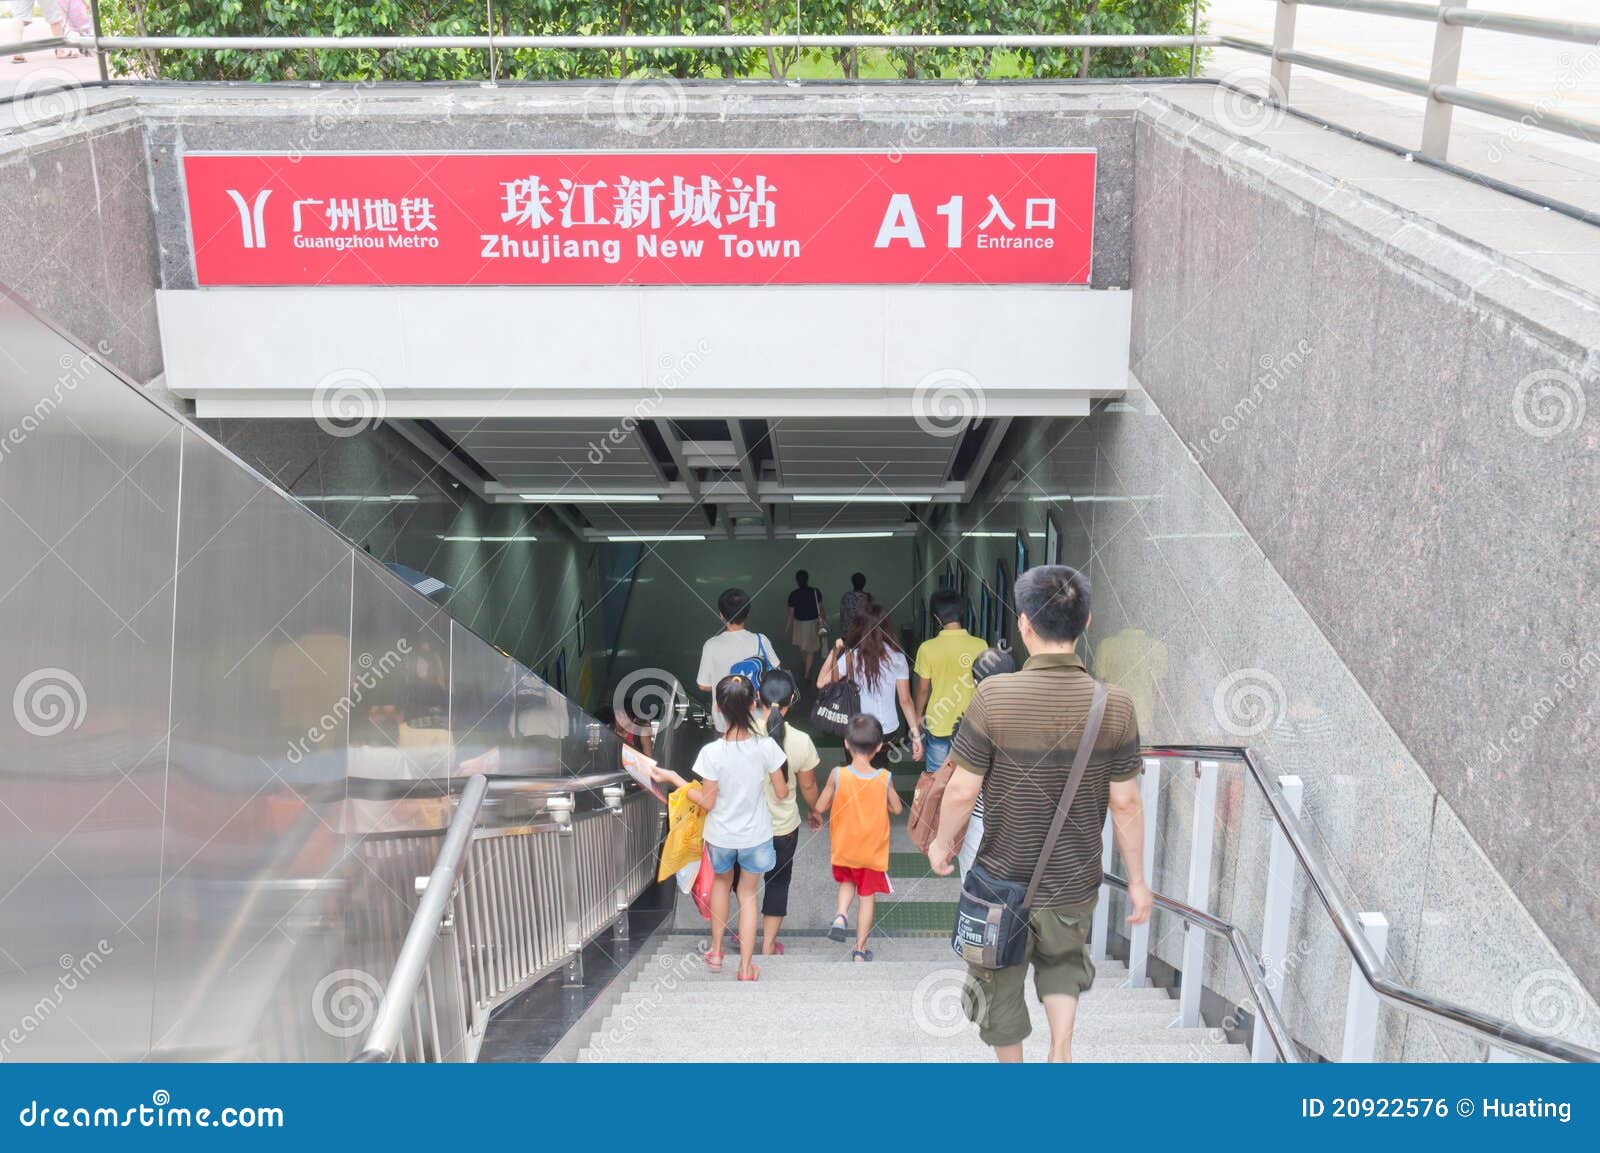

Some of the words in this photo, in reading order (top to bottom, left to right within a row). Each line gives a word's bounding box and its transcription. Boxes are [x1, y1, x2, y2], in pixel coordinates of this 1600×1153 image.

[292, 197, 438, 233] 广州地铁
[499, 175, 778, 229] 珠江新城站
[978, 194, 1056, 231] 入口
[293, 234, 384, 251] Guangzhou
[388, 234, 439, 249] Metro
[480, 234, 621, 264] Zhujiang
[636, 234, 705, 258] New
[718, 234, 801, 258] Town
[977, 234, 1055, 249] Entrance
